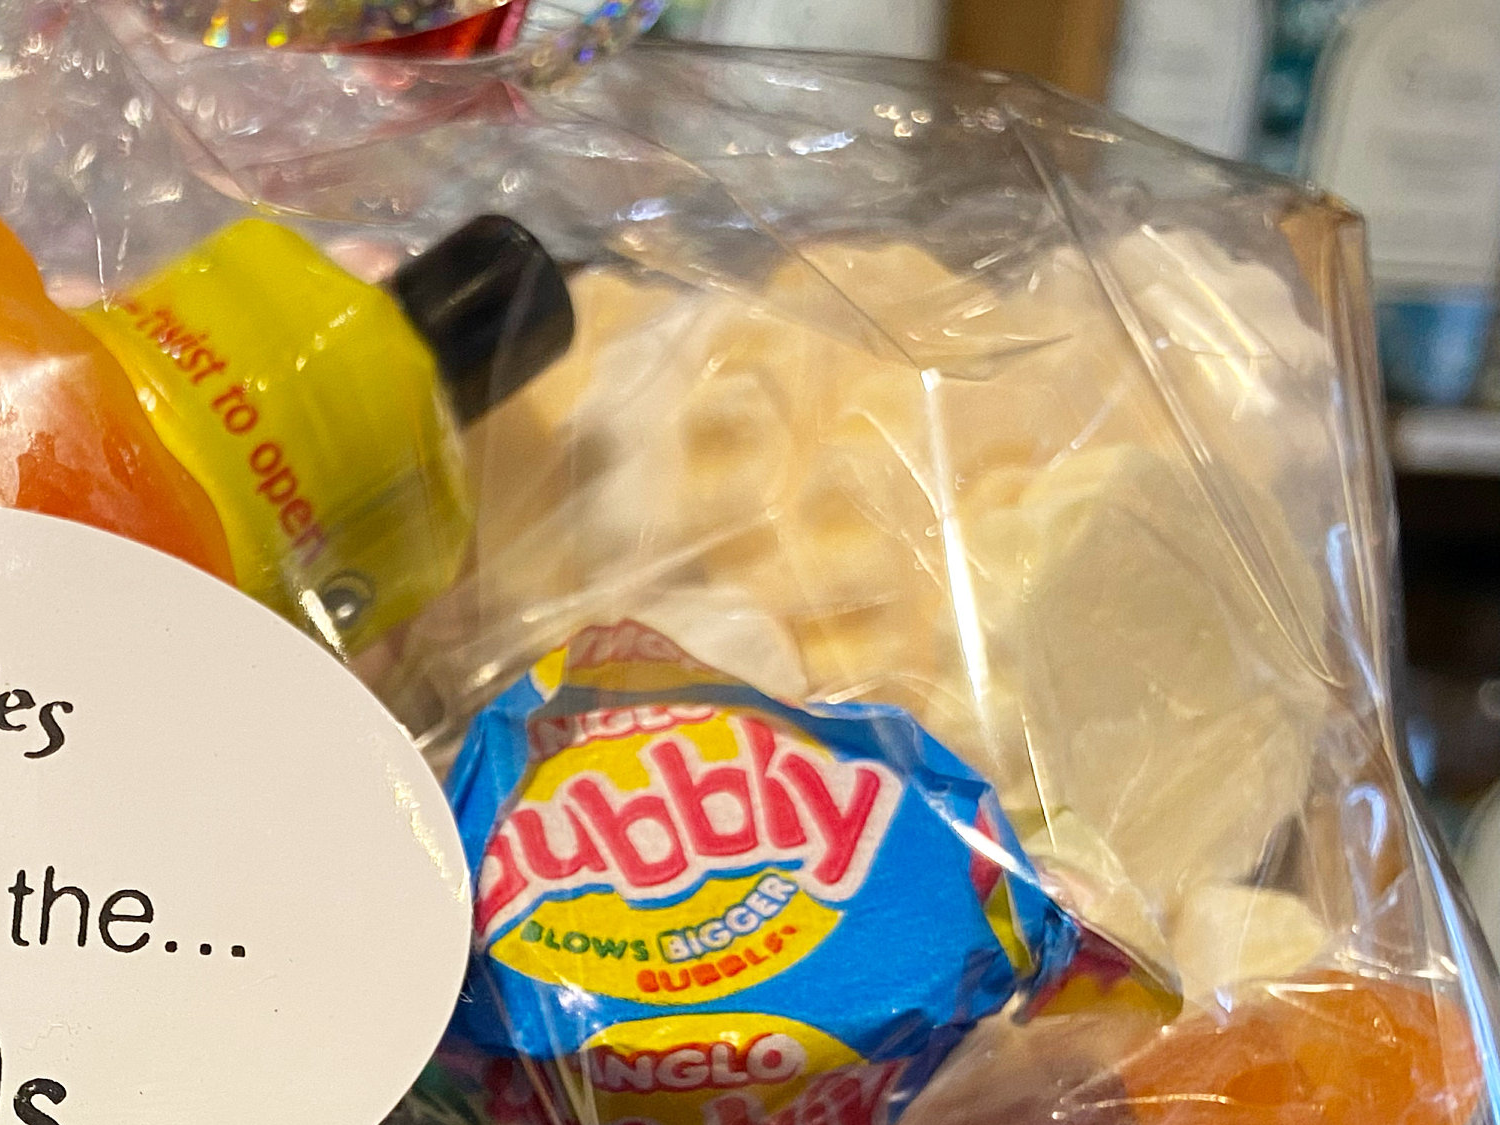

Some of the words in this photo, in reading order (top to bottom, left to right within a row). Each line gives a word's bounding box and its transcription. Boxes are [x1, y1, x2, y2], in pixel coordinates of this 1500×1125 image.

[211, 385, 259, 435] to
[249, 442, 327, 567] open
[7, 866, 246, 958] the...
[520, 919, 650, 963] BLOWS
[656, 872, 800, 964] BIGGER
[588, 1031, 808, 1093] NGLO
